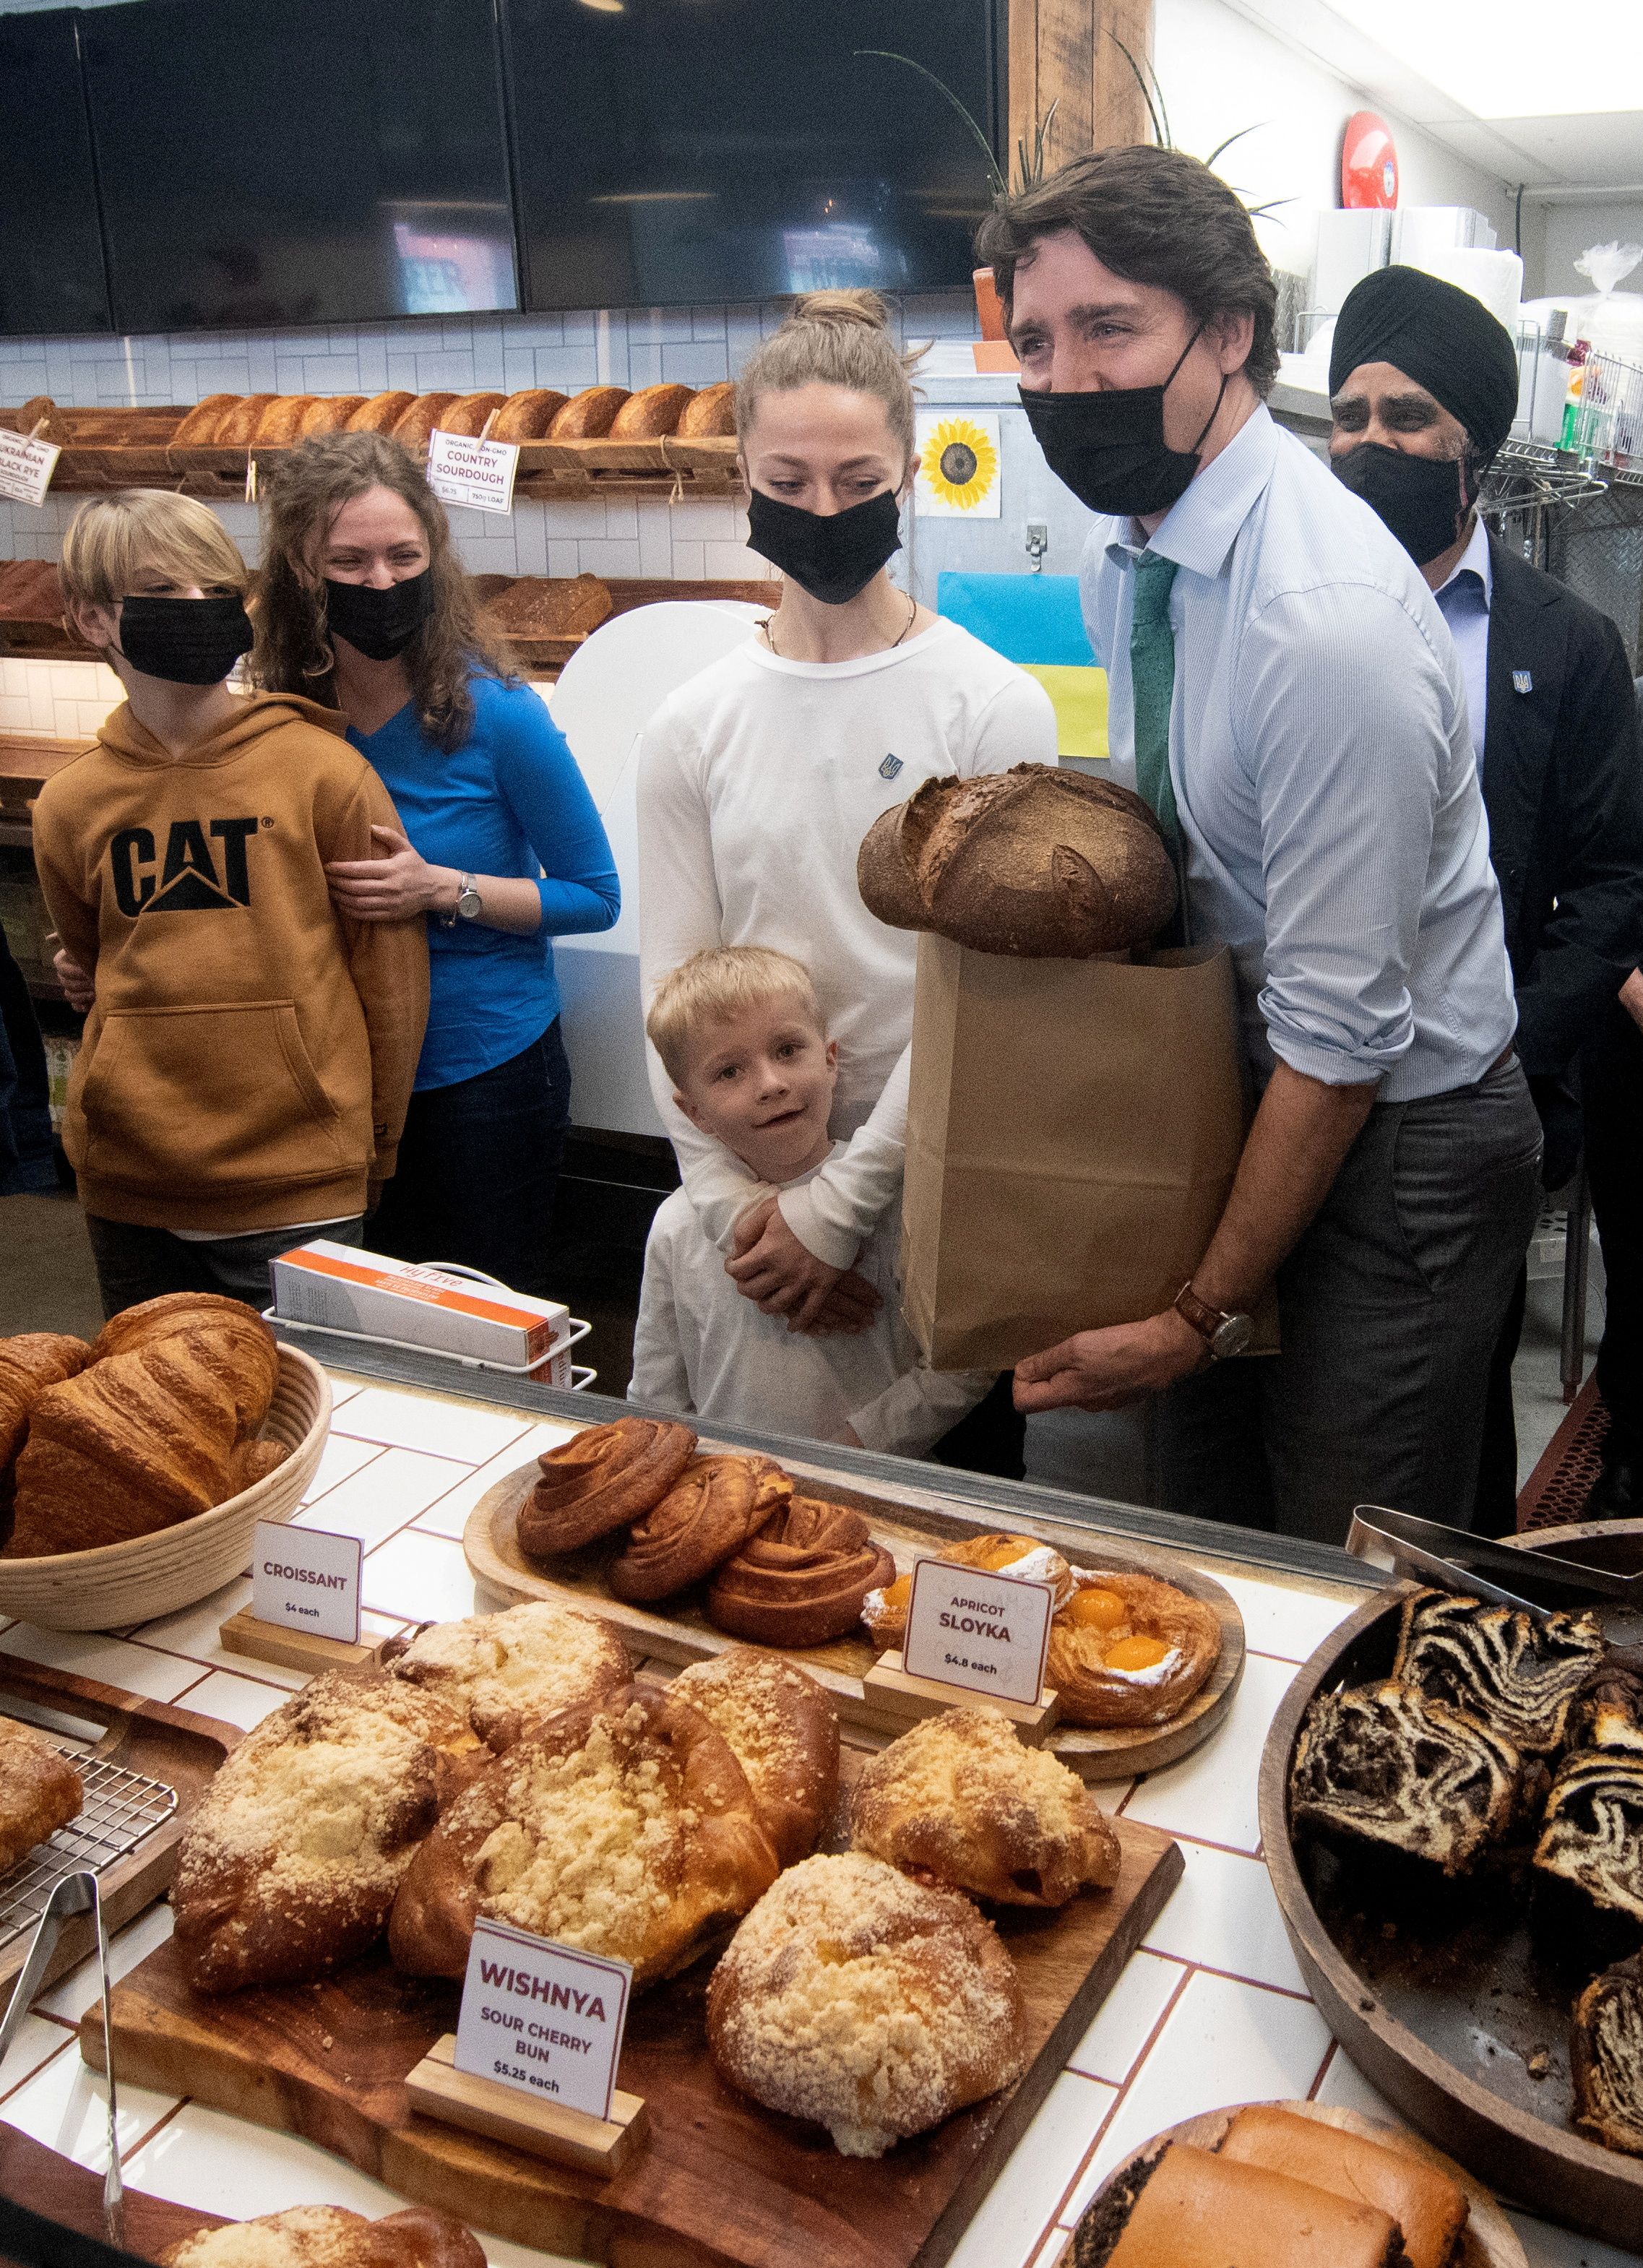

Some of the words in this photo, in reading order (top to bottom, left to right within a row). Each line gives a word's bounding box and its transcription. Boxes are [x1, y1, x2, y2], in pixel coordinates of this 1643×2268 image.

[447, 451, 498, 468] COUNTRY
[480, 445, 507, 456] ON-GMO
[23, 466, 40, 478] RYE
[436, 463, 505, 486] SOURDOUGH
[263, 1561, 348, 1590] CROISSANT
[285, 1602, 297, 1612] $4
[298, 1606, 319, 1618] each
[950, 1597, 1006, 1618] APRICOT
[939, 1612, 1012, 1643] SLOYKA
[944, 1653, 968, 1668] $4.8
[971, 1661, 997, 1675] each
[480, 1959, 605, 2022] WISHNYA
[481, 2006, 524, 2032] SOUR
[527, 2022, 592, 2055] CHERRY
[515, 2040, 550, 2064] BUN
[493, 2060, 526, 2081] $5.25
[529, 2075, 559, 2093] each
